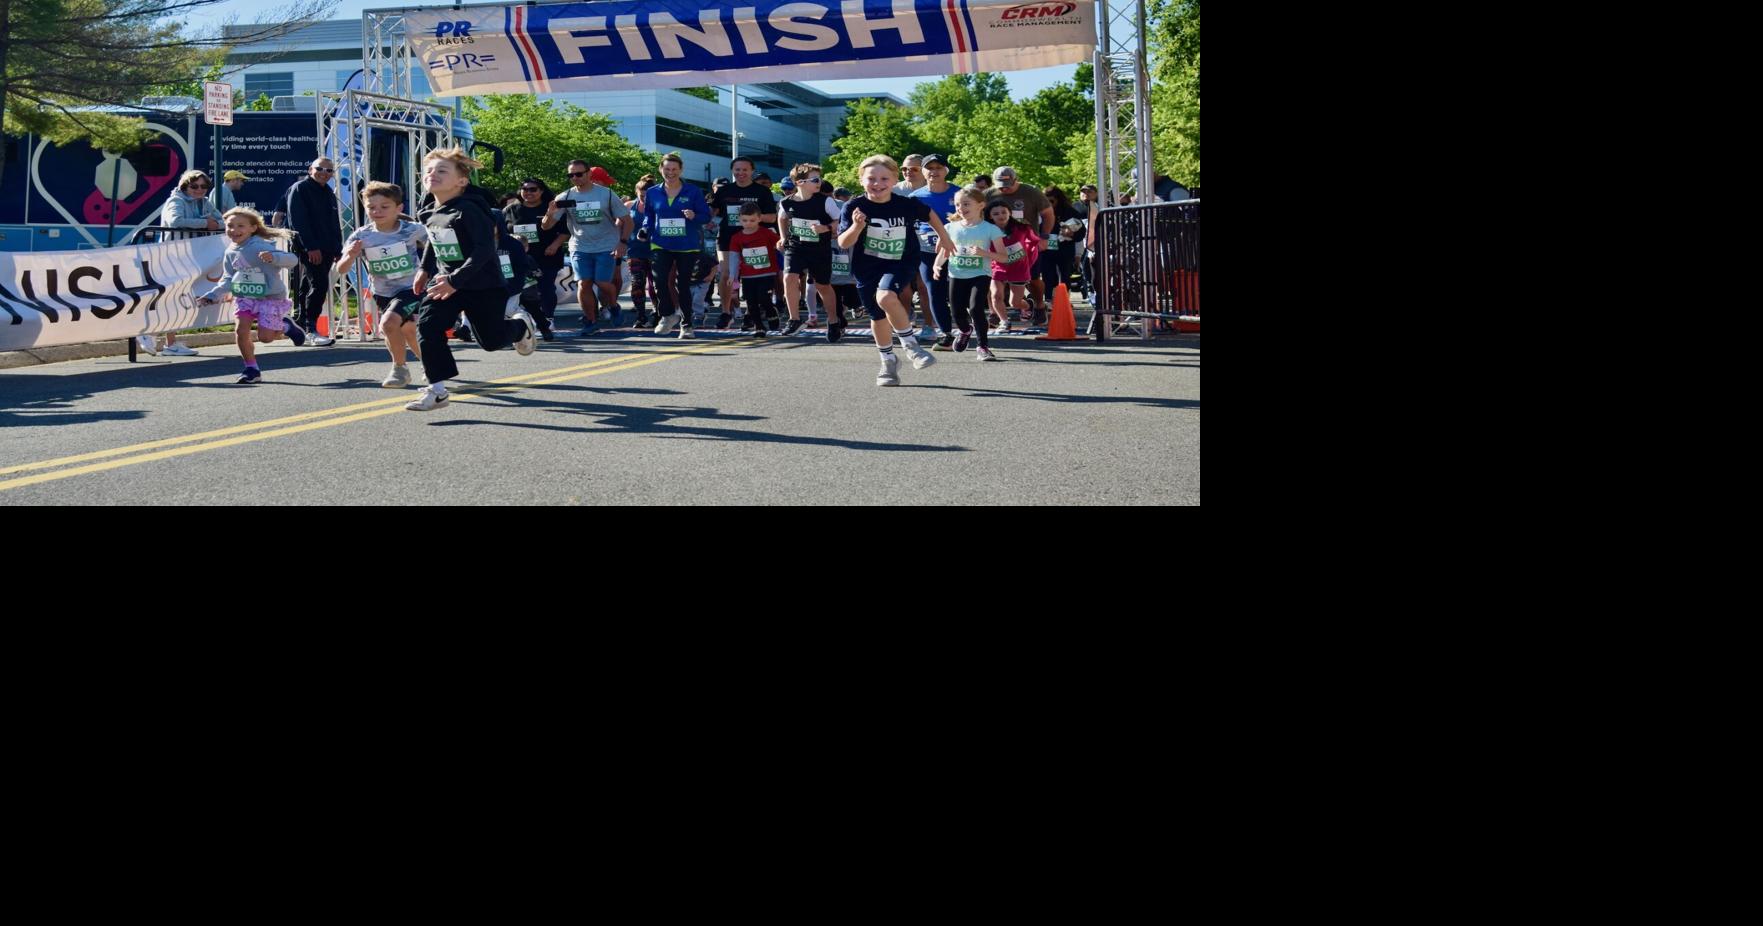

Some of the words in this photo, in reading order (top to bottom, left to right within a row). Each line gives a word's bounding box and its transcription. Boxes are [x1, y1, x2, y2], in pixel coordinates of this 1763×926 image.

[1001, 6, 1065, 20] CRM
[435, 21, 472, 37] PR
[548, 0, 925, 64] FINISH
[437, 37, 475, 46] RACES
[208, 102, 230, 110] STANDING
[578, 209, 599, 218] 5007
[661, 227, 684, 235] 5031
[868, 239, 904, 252] 5012
[373, 257, 409, 272] 5006
[745, 255, 767, 264] 5017
[233, 284, 264, 294] 5009
